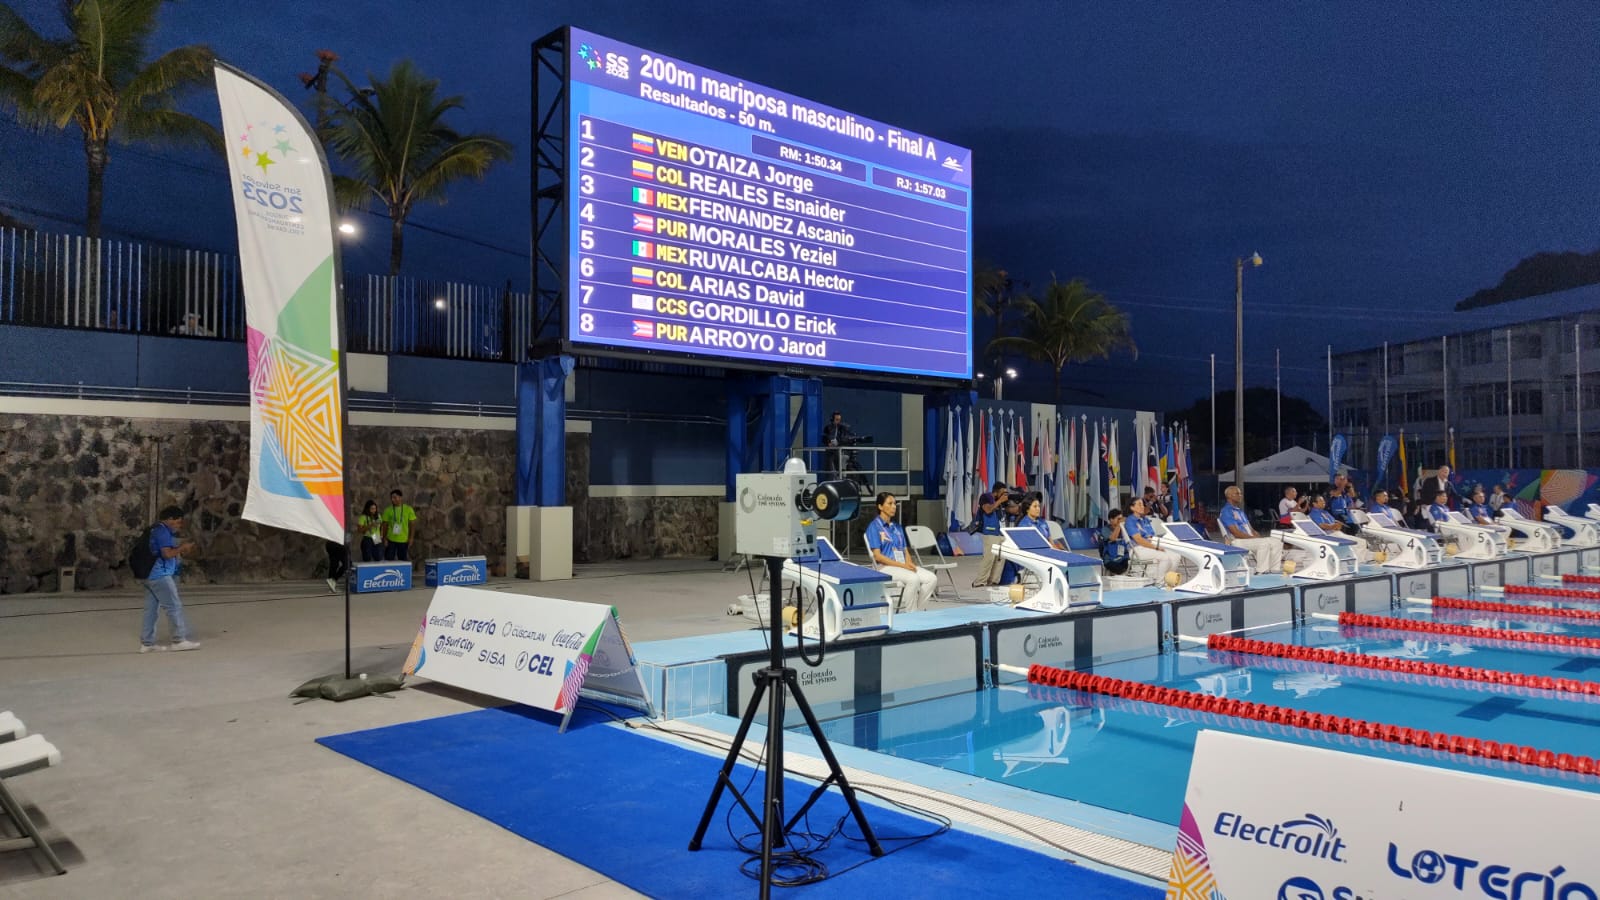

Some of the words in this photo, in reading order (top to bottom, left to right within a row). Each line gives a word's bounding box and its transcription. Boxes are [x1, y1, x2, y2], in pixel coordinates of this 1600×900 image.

[606, 53, 629, 72] SS
[640, 54, 696, 90] 200m
[701, 75, 788, 118] mariposa
[792, 104, 874, 143] masculino
[888, 129, 922, 157] Final
[925, 141, 937, 161] A
[640, 82, 726, 120] Resultados
[738, 111, 755, 128] 50
[758, 118, 776, 134] m.
[581, 120, 595, 140] 1
[656, 139, 687, 162] VEN
[690, 148, 761, 180] OTAIZA
[764, 165, 814, 192] Jorge
[779, 146, 802, 162] RM:
[804, 152, 843, 172] 1:50.34
[580, 147, 594, 167] 2
[656, 166, 687, 188] COL
[690, 174, 768, 205] REALES
[773, 194, 846, 222] Esnaider
[896, 177, 912, 192] RJ:
[914, 182, 946, 199] 1:57.03
[580, 175, 594, 194] 3
[656, 191, 688, 213] MEX
[690, 197, 793, 235] FERNANDEZ
[796, 223, 855, 248] Ascanio
[580, 202, 594, 222] 4
[656, 218, 687, 239] PUR
[690, 225, 786, 256] MORALES
[790, 242, 837, 267] Yeziel
[580, 230, 594, 249] 5
[656, 244, 688, 264] MEX
[690, 251, 801, 283] RUVALCABA
[804, 270, 855, 293] Hector
[580, 258, 594, 277] 6
[656, 270, 687, 291] COL
[689, 278, 751, 300] ARIAS
[755, 287, 804, 309] David
[580, 285, 594, 304] 7
[656, 296, 688, 316] CCS
[690, 301, 790, 330] GORDILLO
[794, 314, 837, 336] Erick
[580, 313, 594, 332] 8
[656, 323, 687, 342] PUR
[689, 327, 774, 351] ARROYO
[778, 336, 826, 358] Jarod
[1478, 533, 1485, 543] 5
[1534, 528, 1540, 537] 6
[1580, 524, 1586, 532] 7
[1319, 545, 1327, 559] 3
[1406, 538, 1414, 549] 4
[1203, 555, 1211, 570] 2
[363, 576, 404, 589] Electrolit
[443, 571, 480, 584] Electrolit
[1047, 566, 1053, 584] 1
[843, 588, 854, 608] 0
[429, 613, 455, 628] Electrolit
[445, 636, 460, 649] Surf
[460, 638, 475, 652] City
[478, 649, 506, 666] SISA
[528, 654, 554, 676] CEL
[801, 668, 833, 680] Colorado
[1213, 812, 1345, 864] Electrolit
